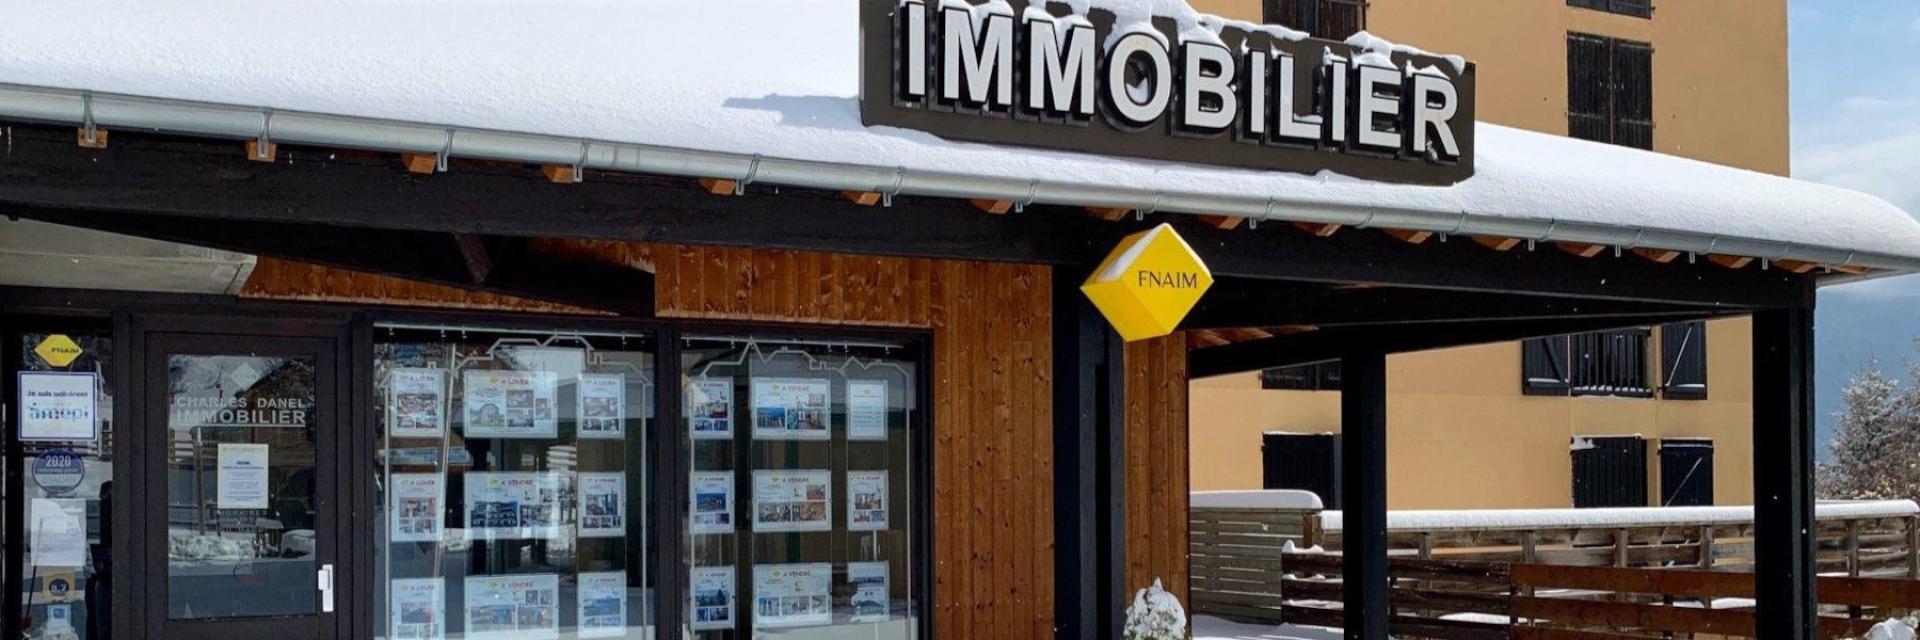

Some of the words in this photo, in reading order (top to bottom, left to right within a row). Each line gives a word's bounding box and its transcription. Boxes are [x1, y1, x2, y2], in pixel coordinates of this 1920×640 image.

[908, 3, 1461, 158] IMMOBILIER
[1138, 270, 1197, 288] FNAIM
[176, 396, 247, 408] CHARLES
[257, 398, 306, 409] DANEL
[176, 409, 306, 424] IMMOBILIER
[46, 455, 71, 467] 2020
